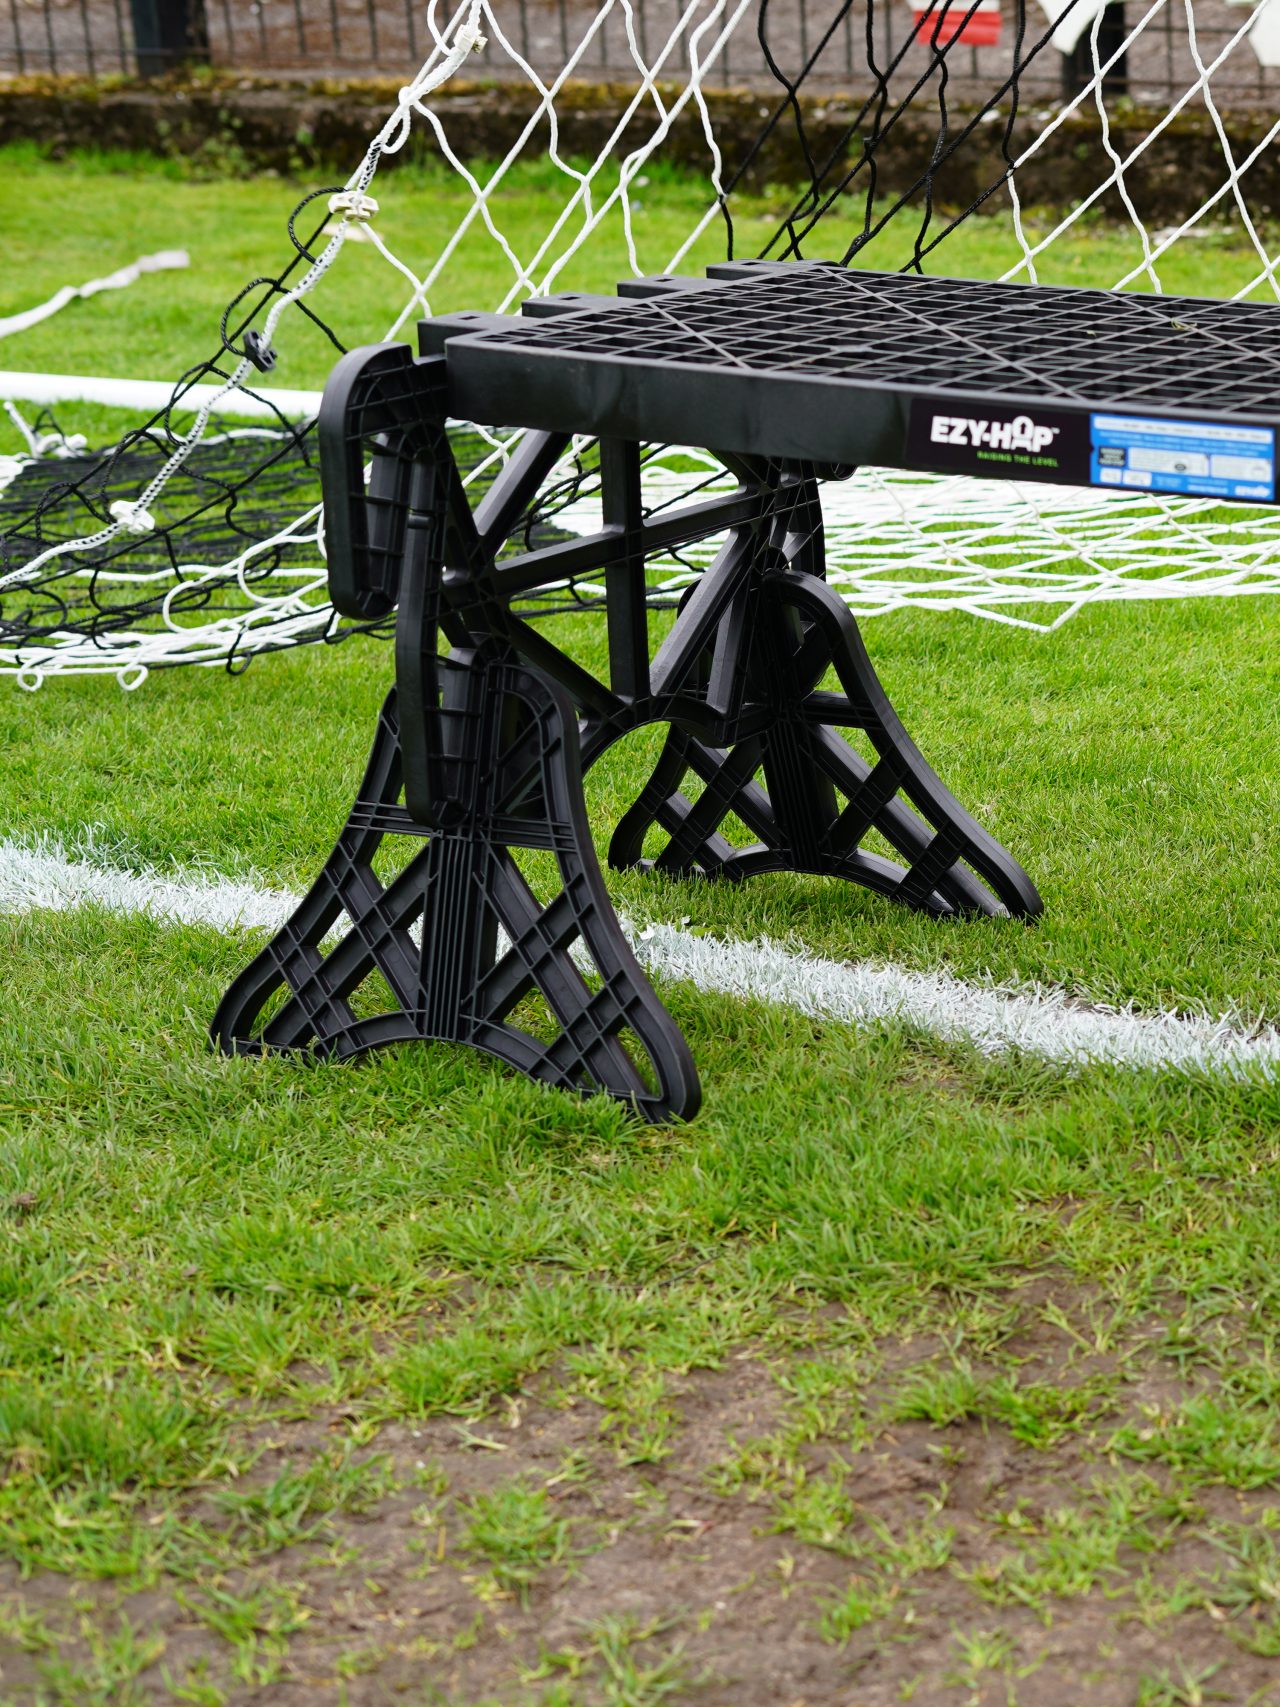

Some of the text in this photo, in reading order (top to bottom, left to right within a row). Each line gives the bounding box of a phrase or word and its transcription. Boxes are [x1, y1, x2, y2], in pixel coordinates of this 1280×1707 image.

[976, 450, 1059, 468] RAISING THE LEVEL
